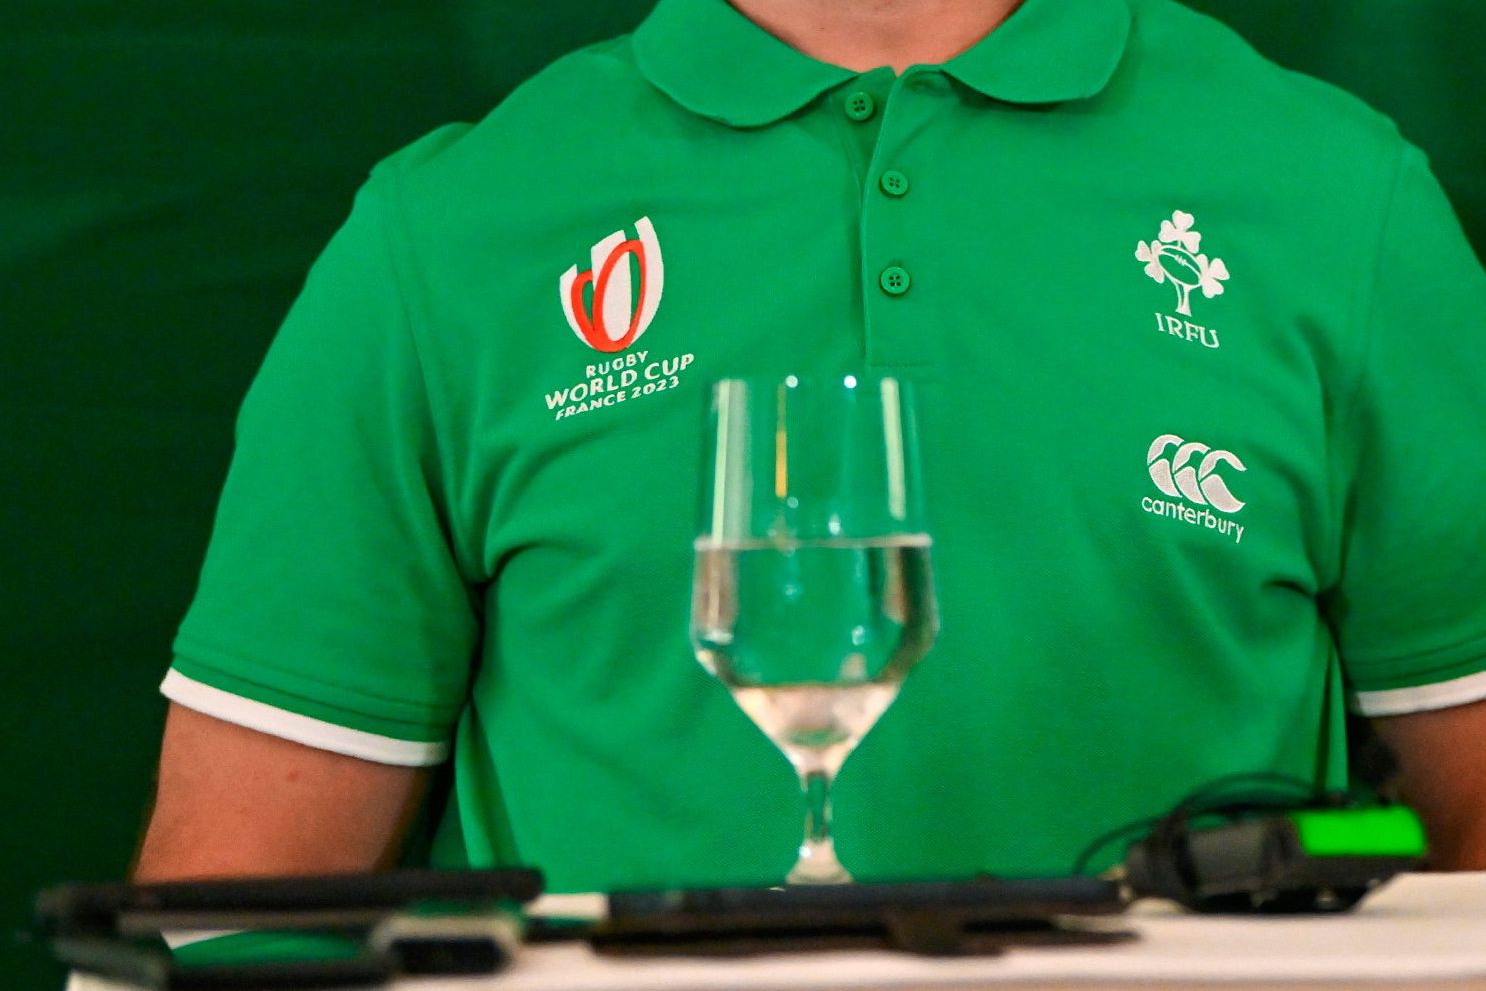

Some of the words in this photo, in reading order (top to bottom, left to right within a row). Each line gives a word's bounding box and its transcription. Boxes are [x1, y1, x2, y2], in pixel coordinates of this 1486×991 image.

[1154, 312, 1220, 349] IRFU
[544, 368, 638, 410] WORLD
[643, 352, 695, 381] CUP
[585, 350, 649, 378] RUGBY
[555, 387, 627, 421] FRANCE
[630, 375, 680, 399] 2023
[1141, 495, 1245, 545] canterbury
